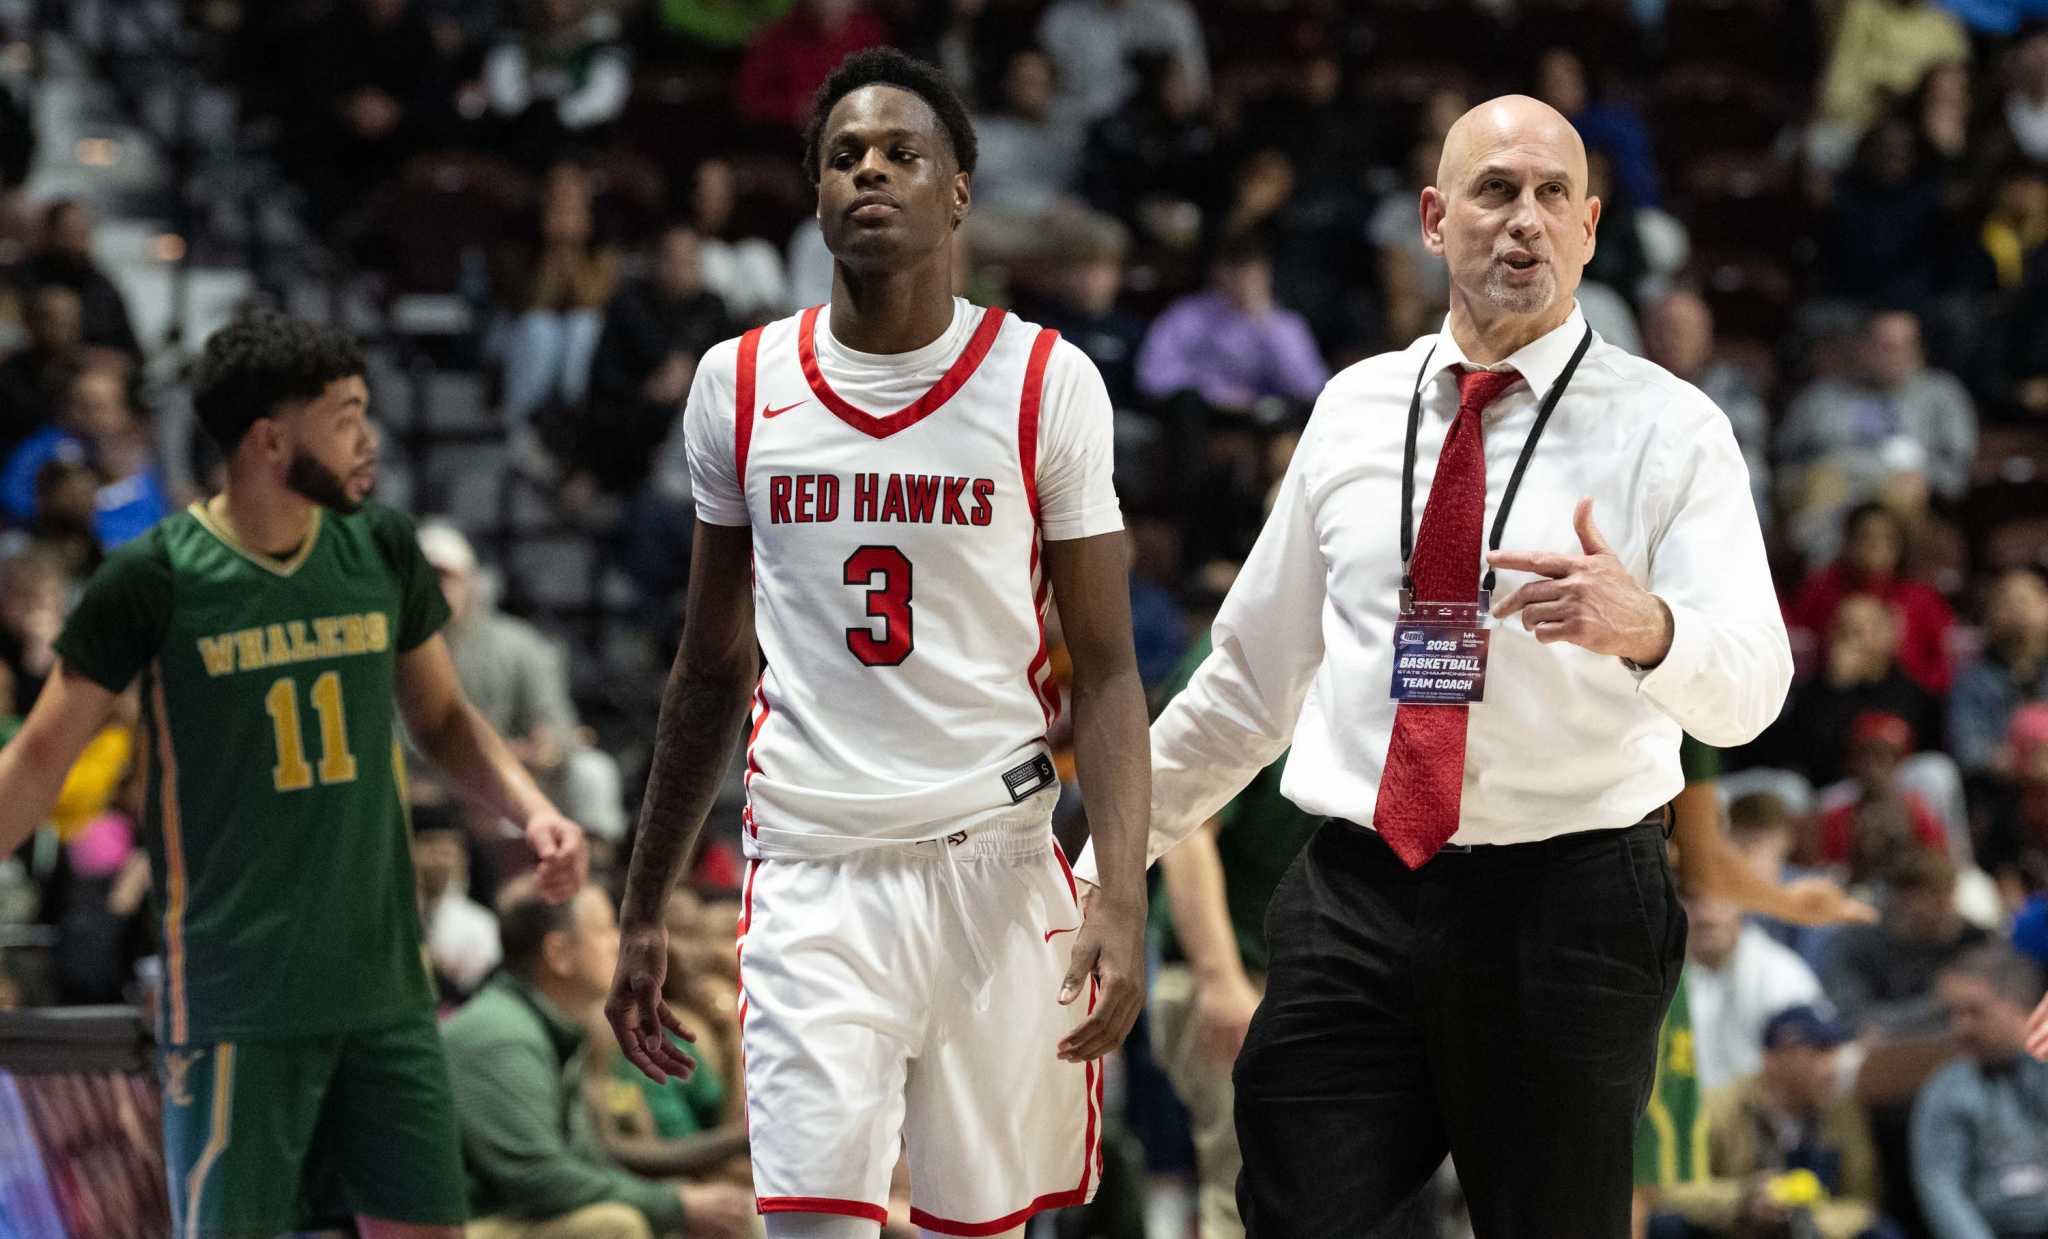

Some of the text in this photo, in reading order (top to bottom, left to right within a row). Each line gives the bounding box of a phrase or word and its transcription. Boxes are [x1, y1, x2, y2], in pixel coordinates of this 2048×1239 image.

[770, 472, 995, 527] RED HAWKS
[843, 545, 914, 667] 3
[197, 612, 389, 678] WHALERS
[1425, 640, 1457, 651] 2025
[1399, 657, 1480, 671] BASKETBALL
[1402, 677, 1473, 690] TEAM COACH
[264, 670, 358, 792] 11
[1041, 763, 1050, 776] S
